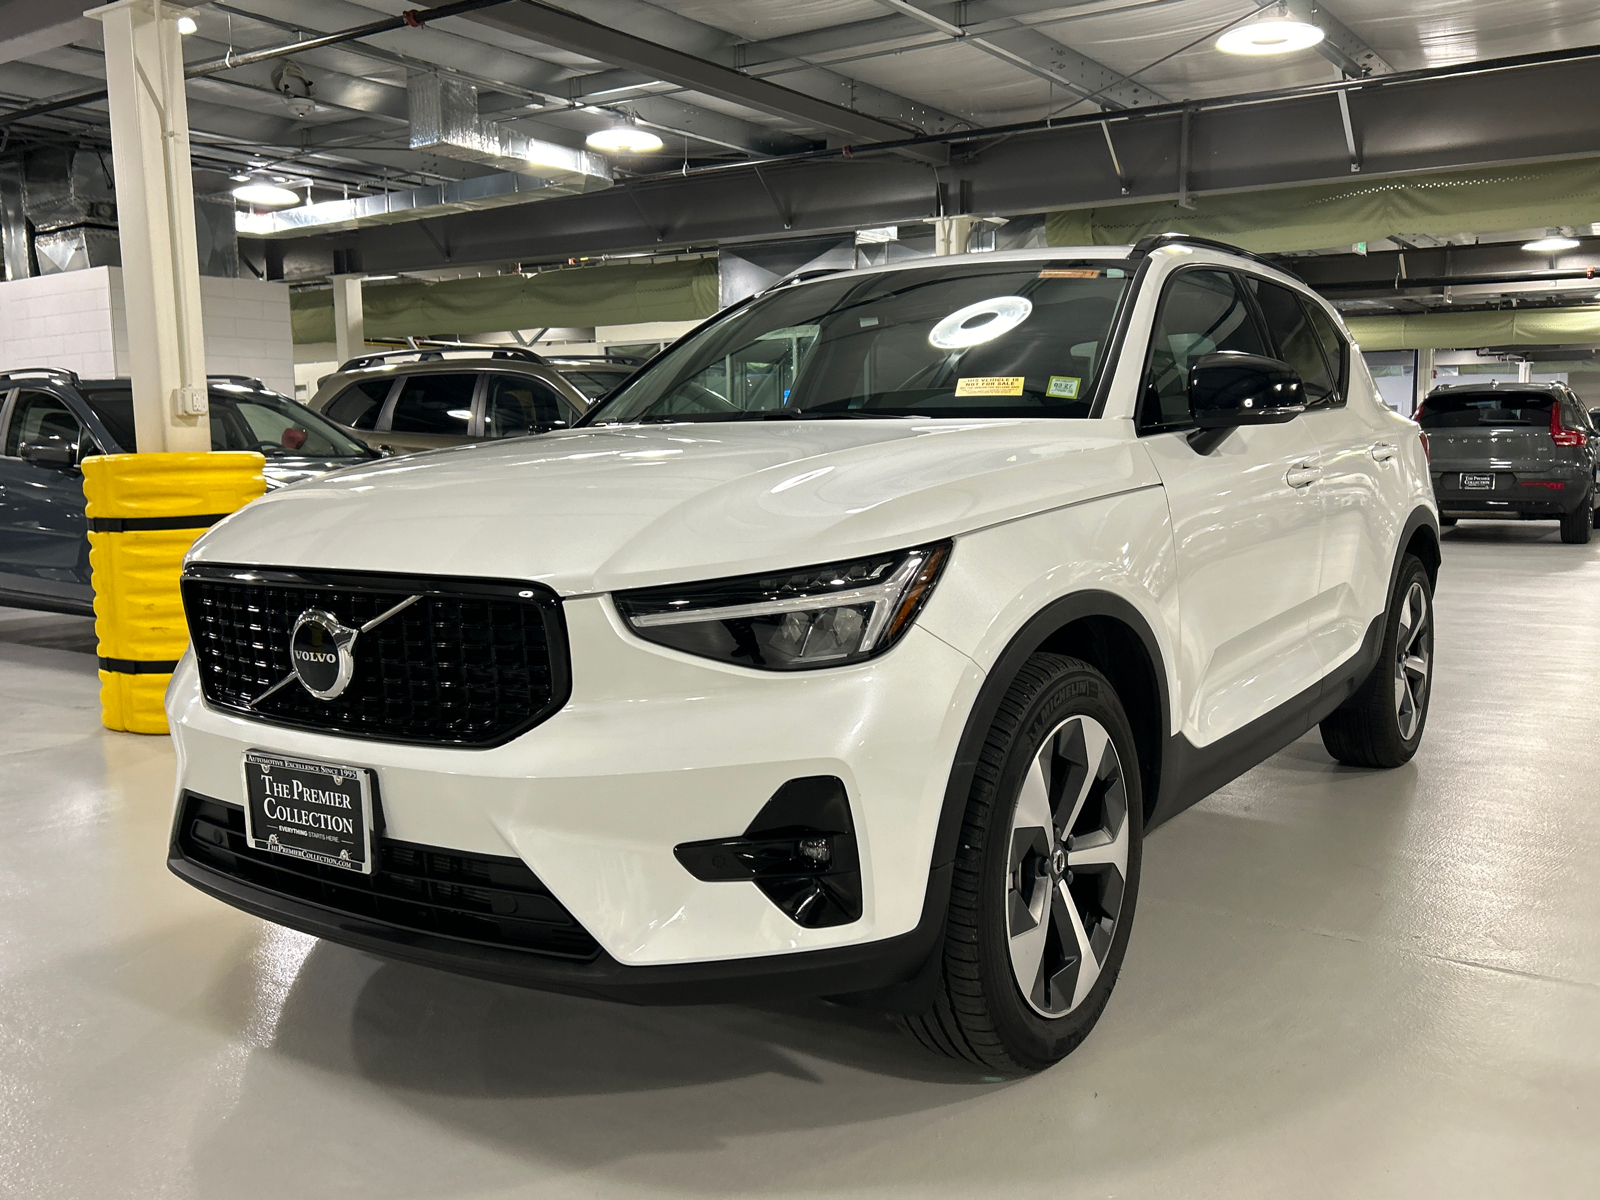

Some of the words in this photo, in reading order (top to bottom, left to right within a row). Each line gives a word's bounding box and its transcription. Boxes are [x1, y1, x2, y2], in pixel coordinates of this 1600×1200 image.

[294, 650, 337, 664] VOLVO
[1041, 681, 1088, 723] MICHELIN
[248, 755, 284, 767] AUTOMOTIVE
[284, 760, 320, 772] EXCELLENCE
[320, 766, 338, 775] SINCE
[340, 769, 357, 779] 1995
[261, 775, 291, 799] THE
[291, 779, 352, 810] PREMIER
[263, 797, 354, 834] COLLECTION
[278, 825, 308, 837] EVERYTHING
[308, 831, 325, 841] STARTS
[325, 835, 340, 844] HERE
